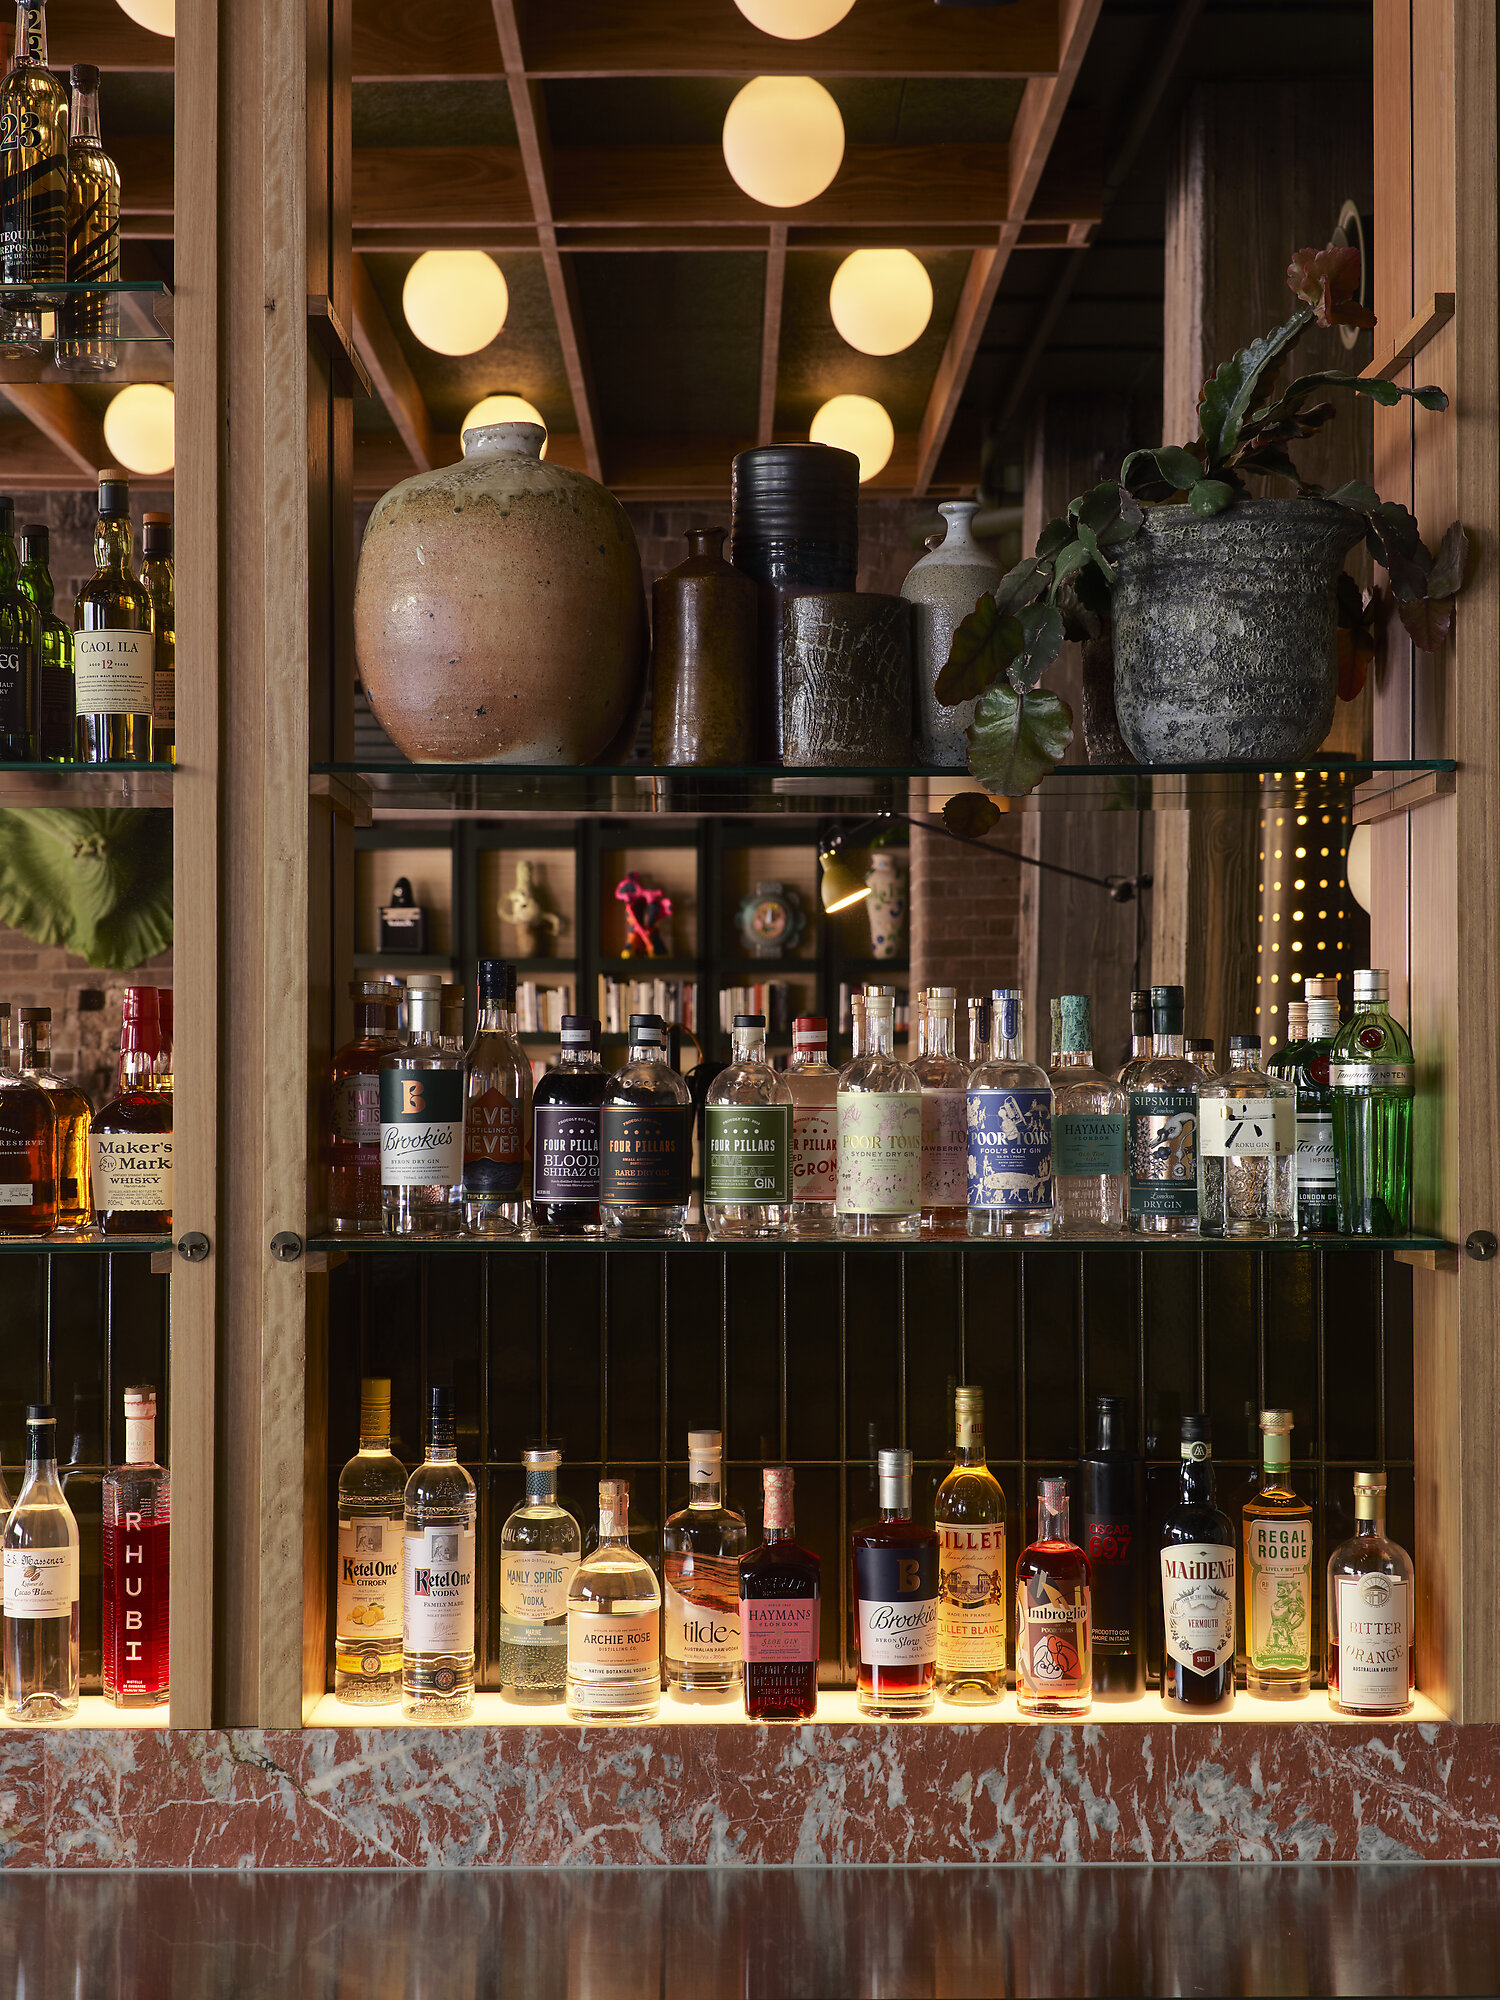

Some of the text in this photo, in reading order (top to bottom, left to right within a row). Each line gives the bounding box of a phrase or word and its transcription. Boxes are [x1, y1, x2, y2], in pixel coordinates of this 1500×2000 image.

[0, 112, 41, 151] 23
[0, 230, 47, 242] TEQUILA
[81, 641, 138, 653] CAOL ILA
[102, 659, 113, 669] 12
[1391, 1071, 1406, 1079] TEN
[1135, 1096, 1193, 1106] SIPSMITH
[1150, 1107, 1174, 1115] London
[383, 1126, 453, 1152] Brookie's
[543, 1138, 566, 1151] FOUR
[842, 1134, 920, 1149] POOR TOMS
[971, 1131, 1009, 1146] POOR
[98, 1141, 173, 1153] Maker's
[609, 1140, 676, 1153] FOUR PILLARS
[711, 1139, 776, 1152] FOUR PILLARS
[119, 1157, 173, 1170] Mark
[543, 1167, 587, 1177] SHIRAZ
[615, 1169, 636, 1177] RARE
[754, 1178, 776, 1189] GIN
[1150, 1192, 1175, 1200] London
[1143, 1200, 1182, 1209] DRY GIN
[1258, 1529, 1307, 1544] REGAL
[1089, 1535, 1131, 1559] 697
[1258, 1544, 1307, 1559] ROGUE
[343, 1558, 398, 1584] Ketel One
[506, 1566, 569, 1586] MANLY SPIRITS
[125, 1511, 143, 1661] RHUBI
[356, 1579, 387, 1587] CITROEN
[415, 1570, 471, 1595] Ketel One
[432, 1589, 459, 1597] VODKA
[520, 1593, 548, 1608] VODKA
[749, 1609, 811, 1621] HAYMANS
[1028, 1606, 1087, 1623] Imbroglio
[940, 1623, 1000, 1635] LILLET BLANC
[1187, 1618, 1219, 1628] VERMOUTH
[1349, 1622, 1402, 1635] BITTER
[583, 1632, 651, 1645] ARCHIE ROSE
[894, 1636, 920, 1650] Slow
[1196, 1655, 1211, 1663] SWEET
[1345, 1644, 1404, 1664] ORANGE
